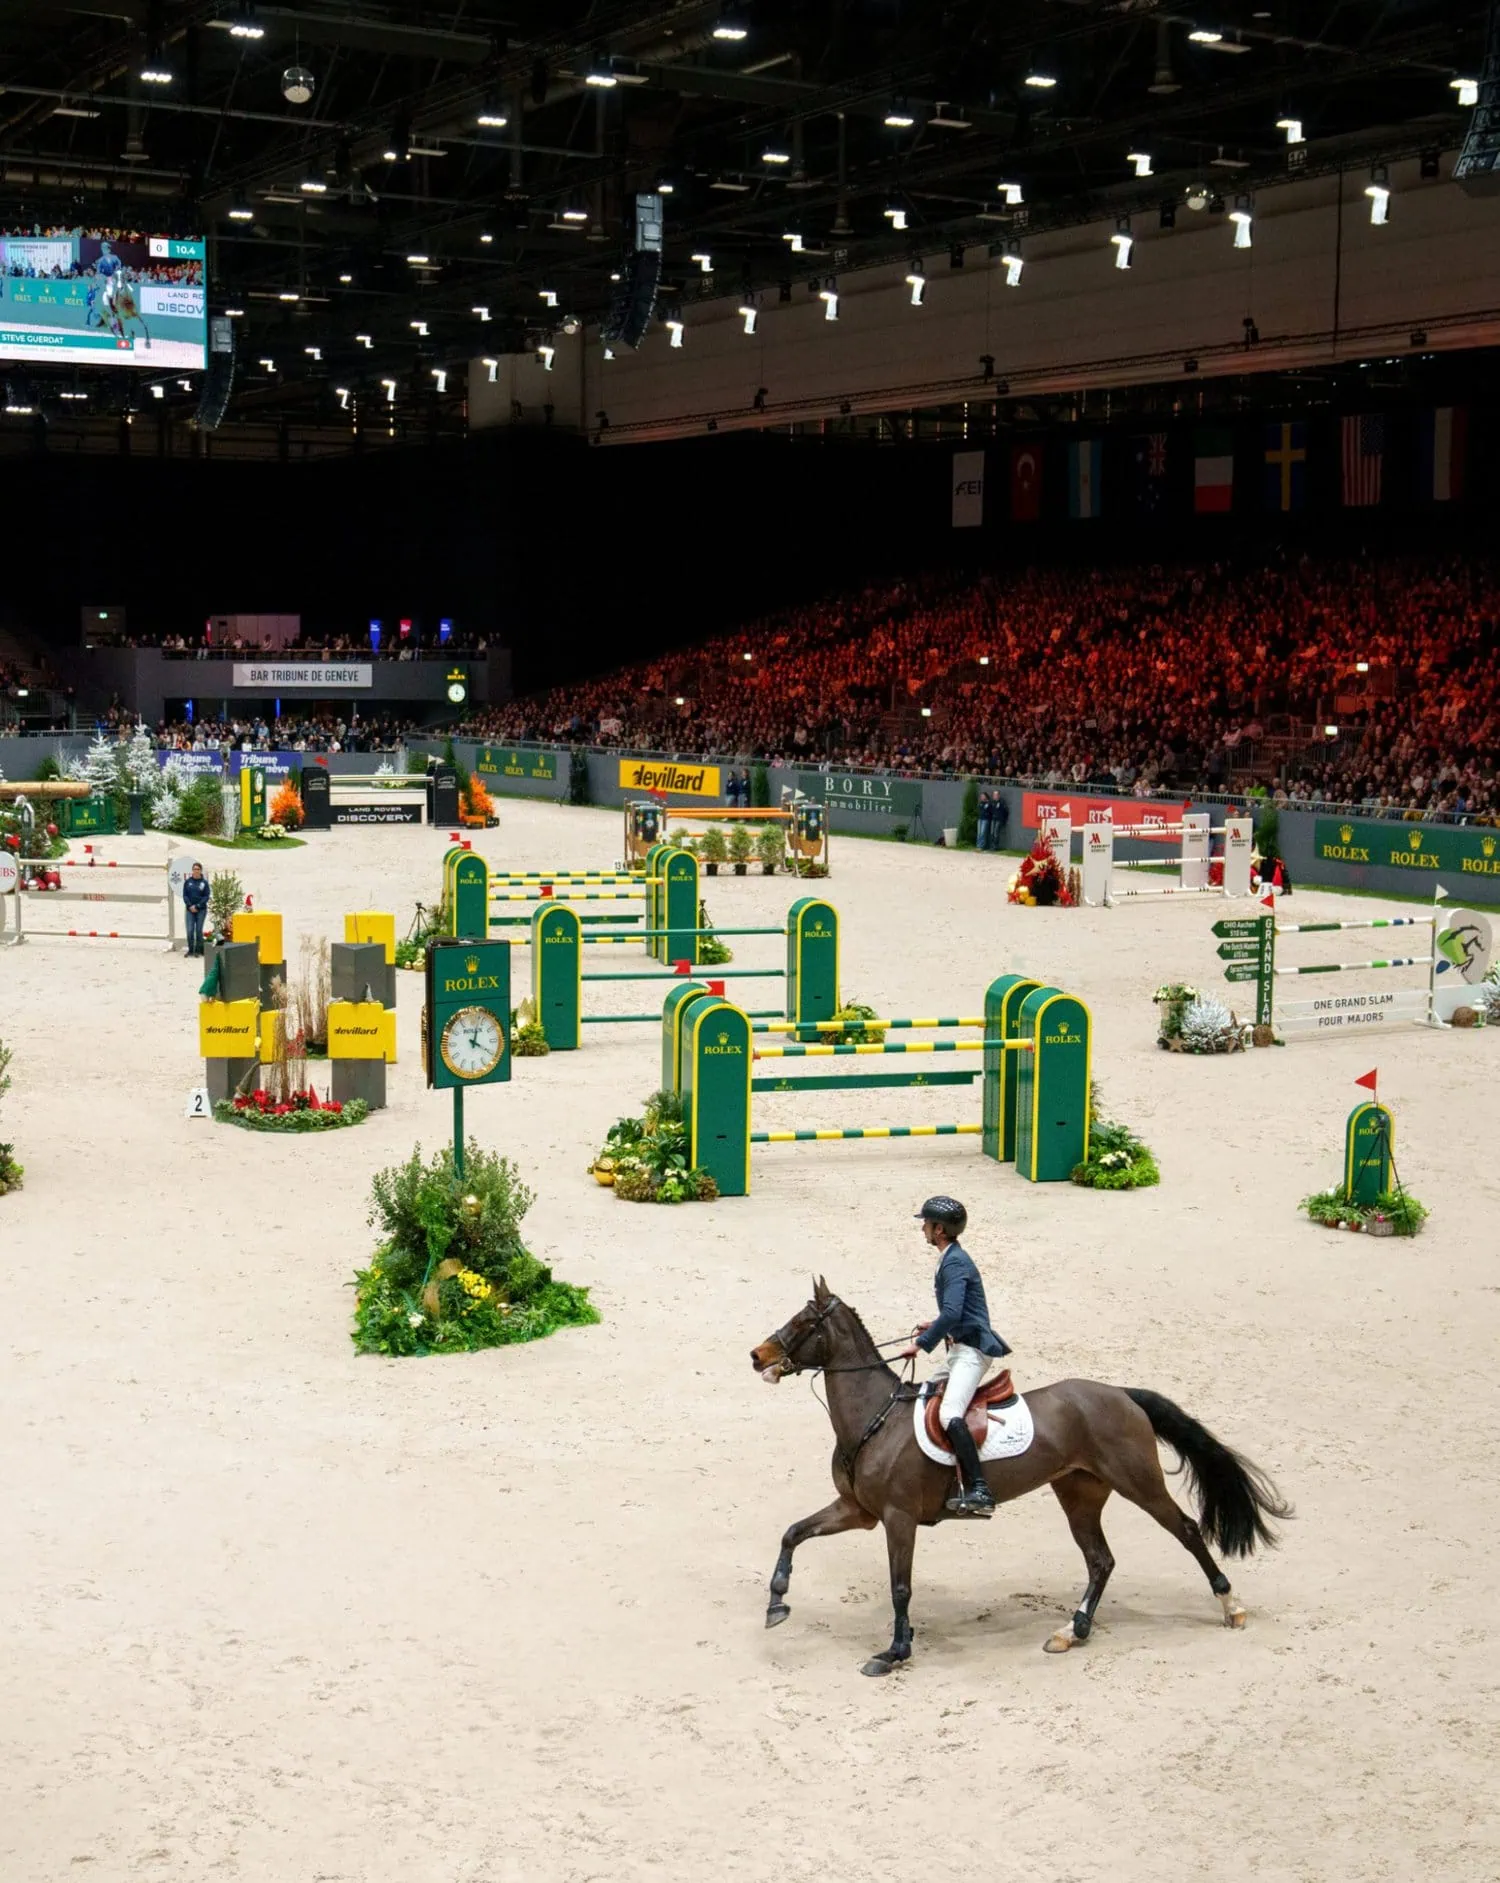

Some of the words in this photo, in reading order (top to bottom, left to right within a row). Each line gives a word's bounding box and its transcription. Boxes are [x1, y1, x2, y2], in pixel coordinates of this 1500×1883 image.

[156, 244, 163, 253] 0
[175, 245, 196, 255] 10.4
[168, 291, 189, 299] LAND
[1, 333, 26, 343] STEVE
[27, 335, 64, 345] GUERDAT
[251, 670, 269, 681] BAR
[272, 670, 309, 681] TRIBUNE
[311, 670, 322, 681] DE
[240, 753, 278, 764] Tribune
[633, 764, 705, 791] devillard
[825, 776, 892, 797] BORY
[824, 796, 893, 813] immobilier
[1037, 804, 1057, 818] RTS
[337, 814, 413, 823] DISCOVERY
[1088, 809, 1109, 824] RTS
[1143, 815, 1164, 825] RTS
[1323, 844, 1369, 861] ROLEX
[1390, 851, 1440, 868] ROLEX
[1264, 918, 1273, 974] GRAND
[445, 975, 499, 992] ROLEX
[1261, 980, 1271, 1025] SLAM
[1314, 1000, 1333, 1010] ONE
[1335, 997, 1367, 1008] GRAND
[1369, 995, 1394, 1005] SLAM
[1319, 1015, 1343, 1026] FOUR
[1347, 1012, 1384, 1024] MAJORS
[206, 1026, 249, 1034] devillard
[334, 1026, 378, 1035] devillard
[1045, 1034, 1082, 1044] ROLEX
[704, 1045, 742, 1055] ROLEX
[195, 1094, 203, 1112] 2
